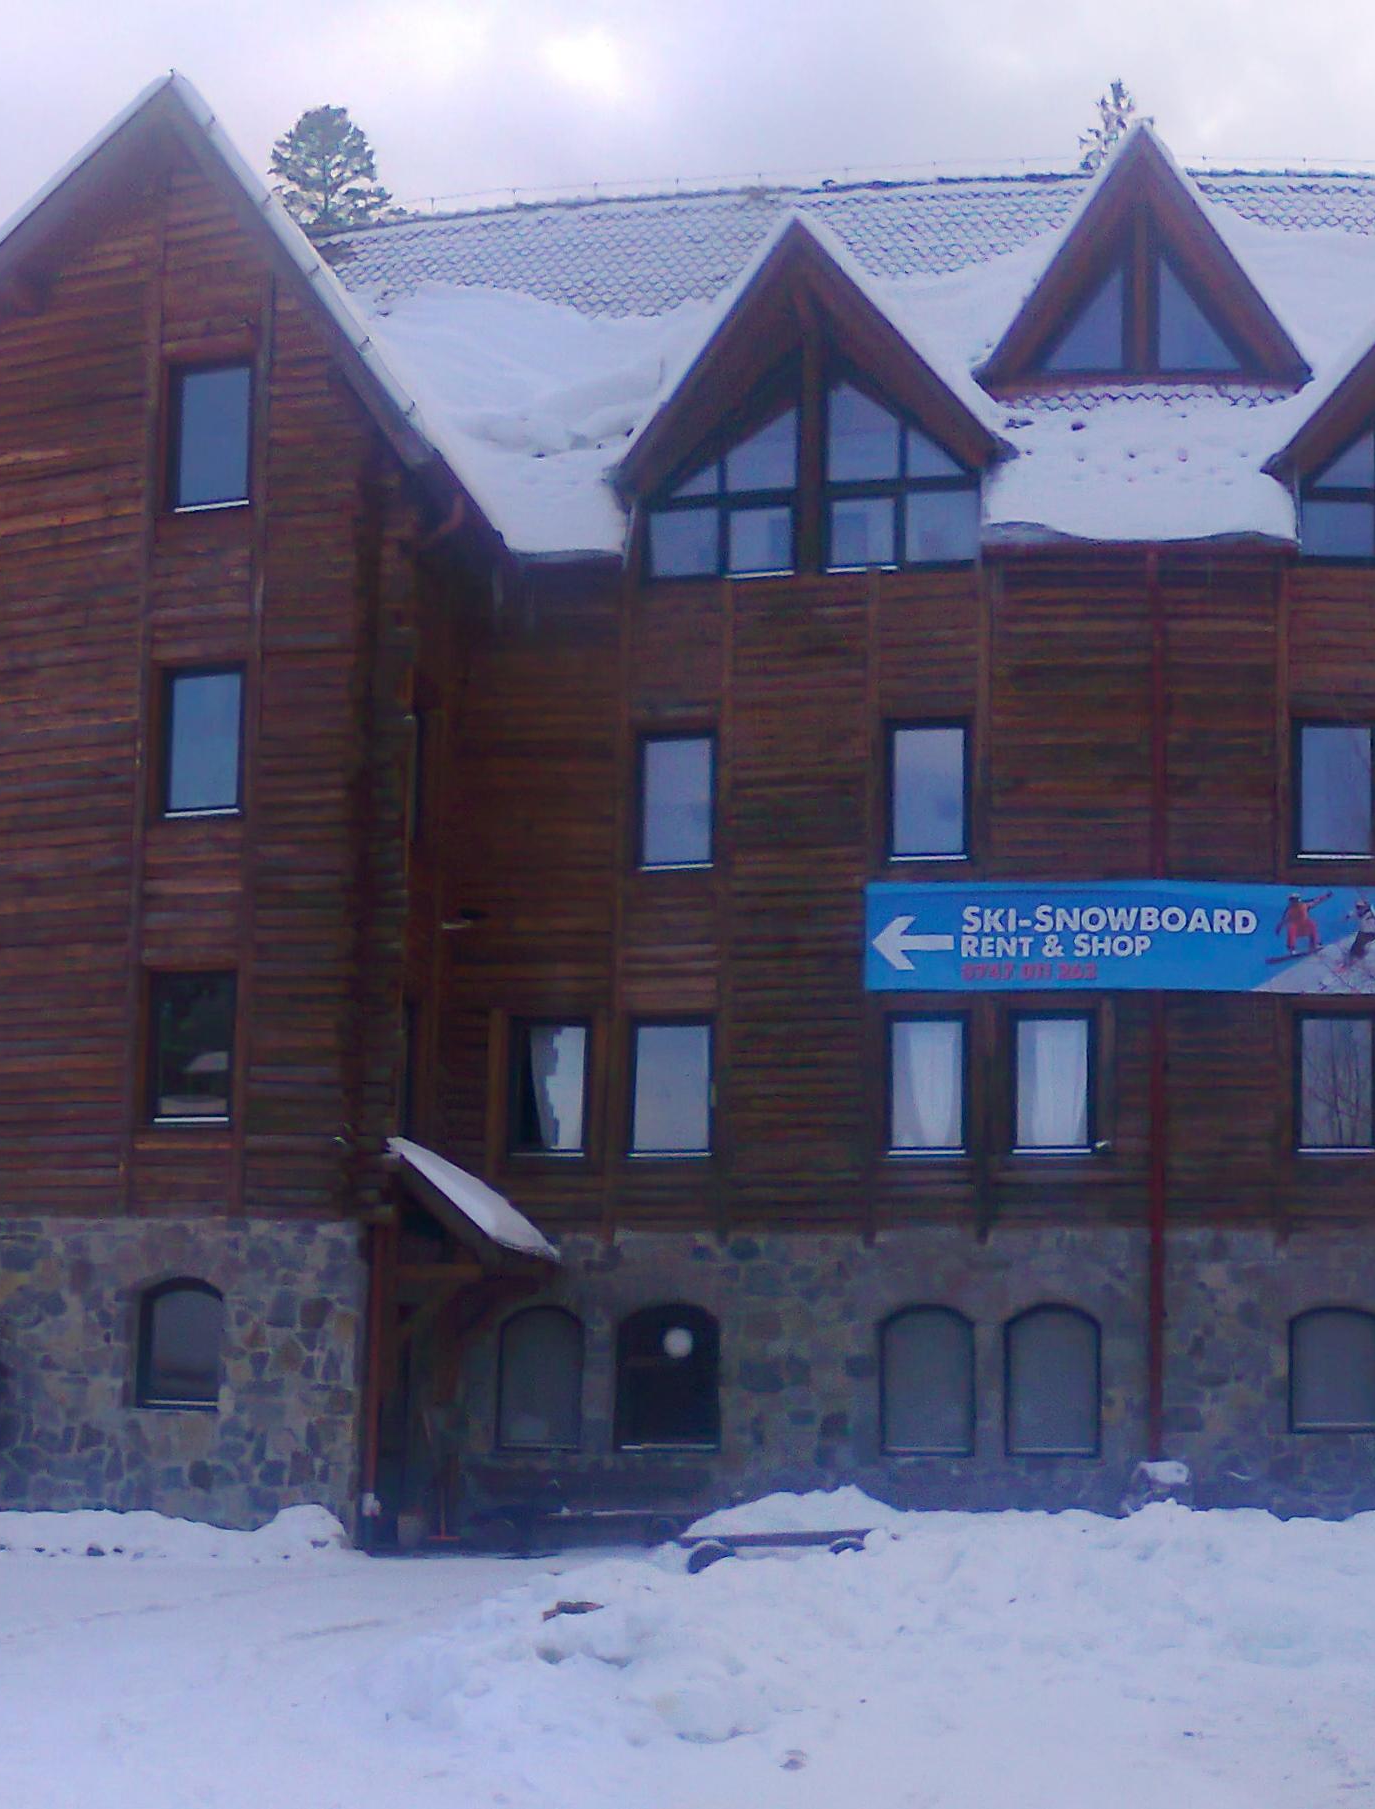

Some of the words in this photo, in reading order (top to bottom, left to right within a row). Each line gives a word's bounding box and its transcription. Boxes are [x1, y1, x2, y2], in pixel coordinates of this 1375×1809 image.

[961, 905, 1257, 935] SKI-SNOWBOARD
[961, 935, 1034, 958] RENT
[1041, 934, 1065, 958] &
[1073, 934, 1152, 958] SHOP
